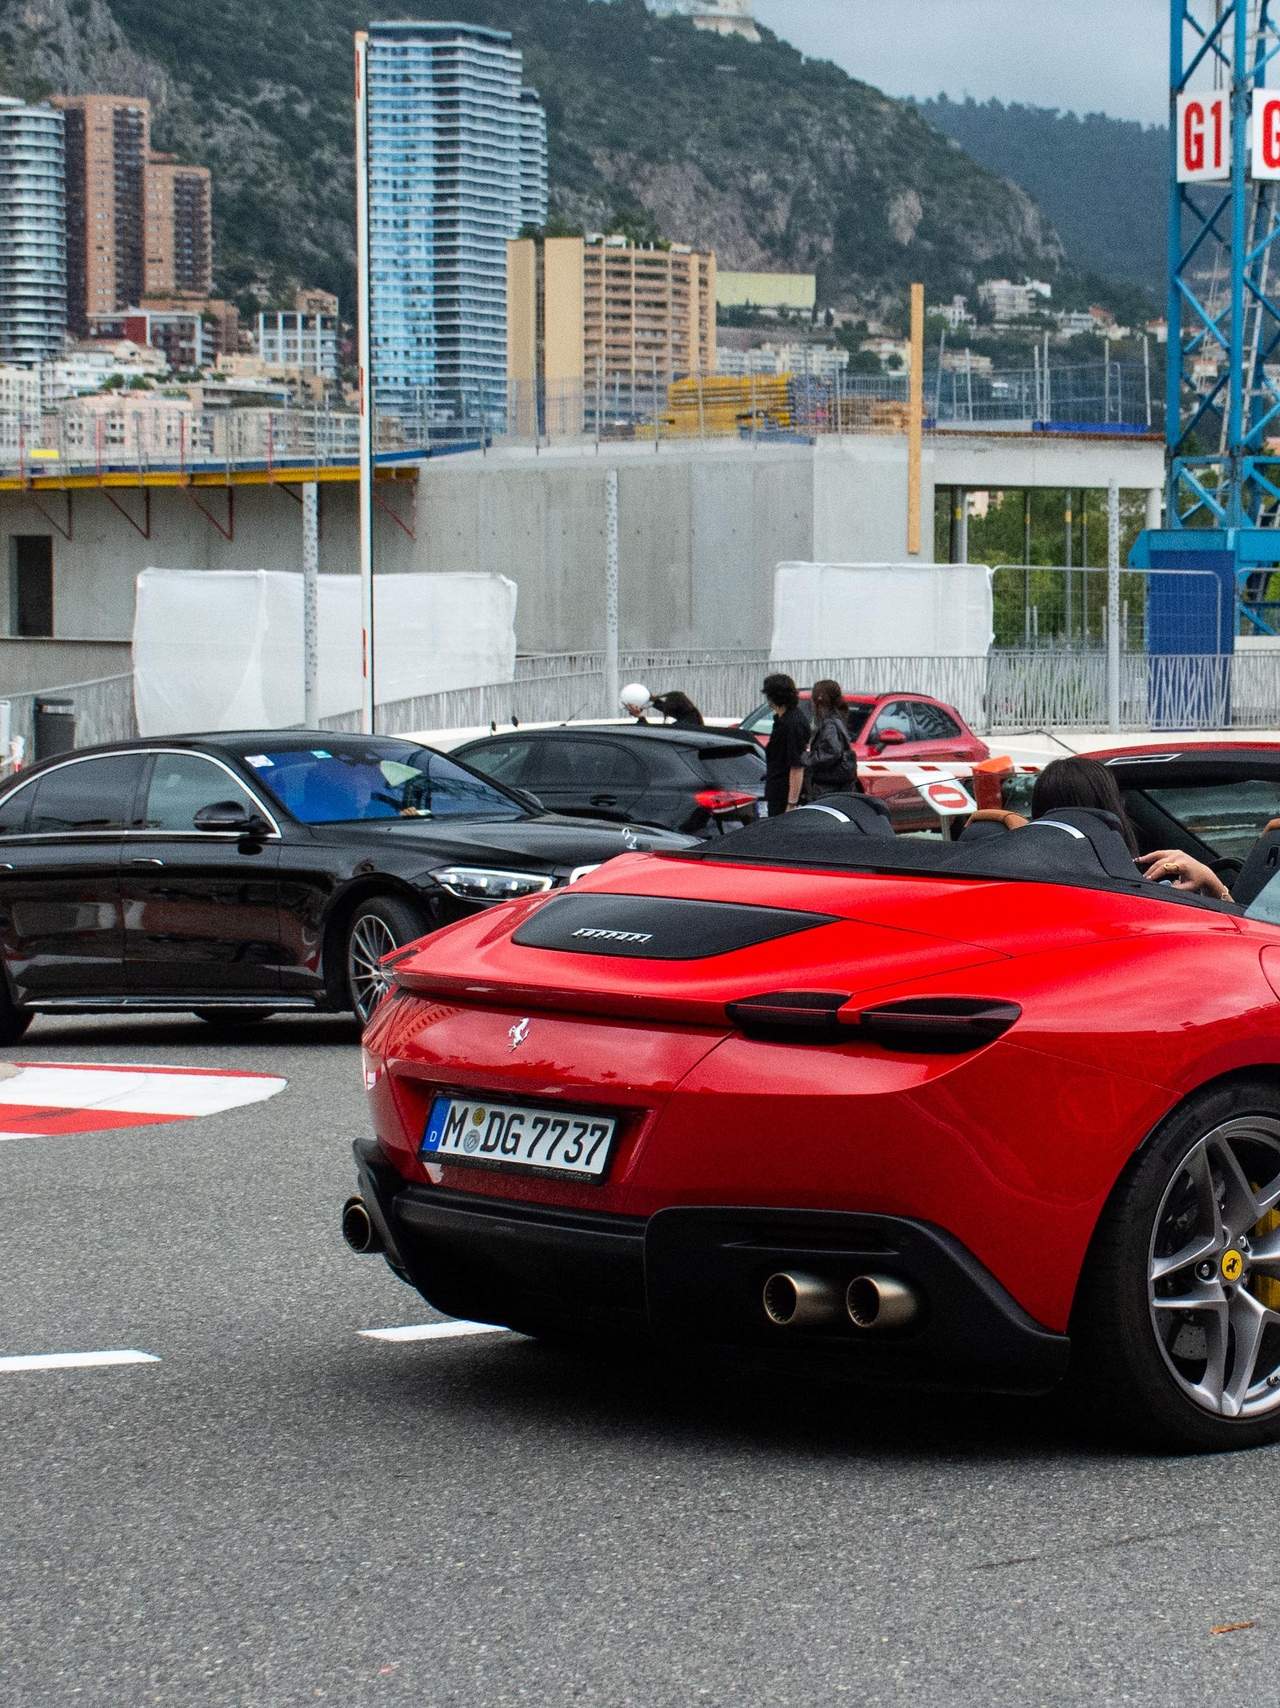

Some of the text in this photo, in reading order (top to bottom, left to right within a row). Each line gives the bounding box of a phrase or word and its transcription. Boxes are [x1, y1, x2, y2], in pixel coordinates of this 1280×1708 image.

[1184, 100, 1222, 171] G1
[429, 1130, 438, 1143] D
[441, 1105, 610, 1166] M DG 7737
